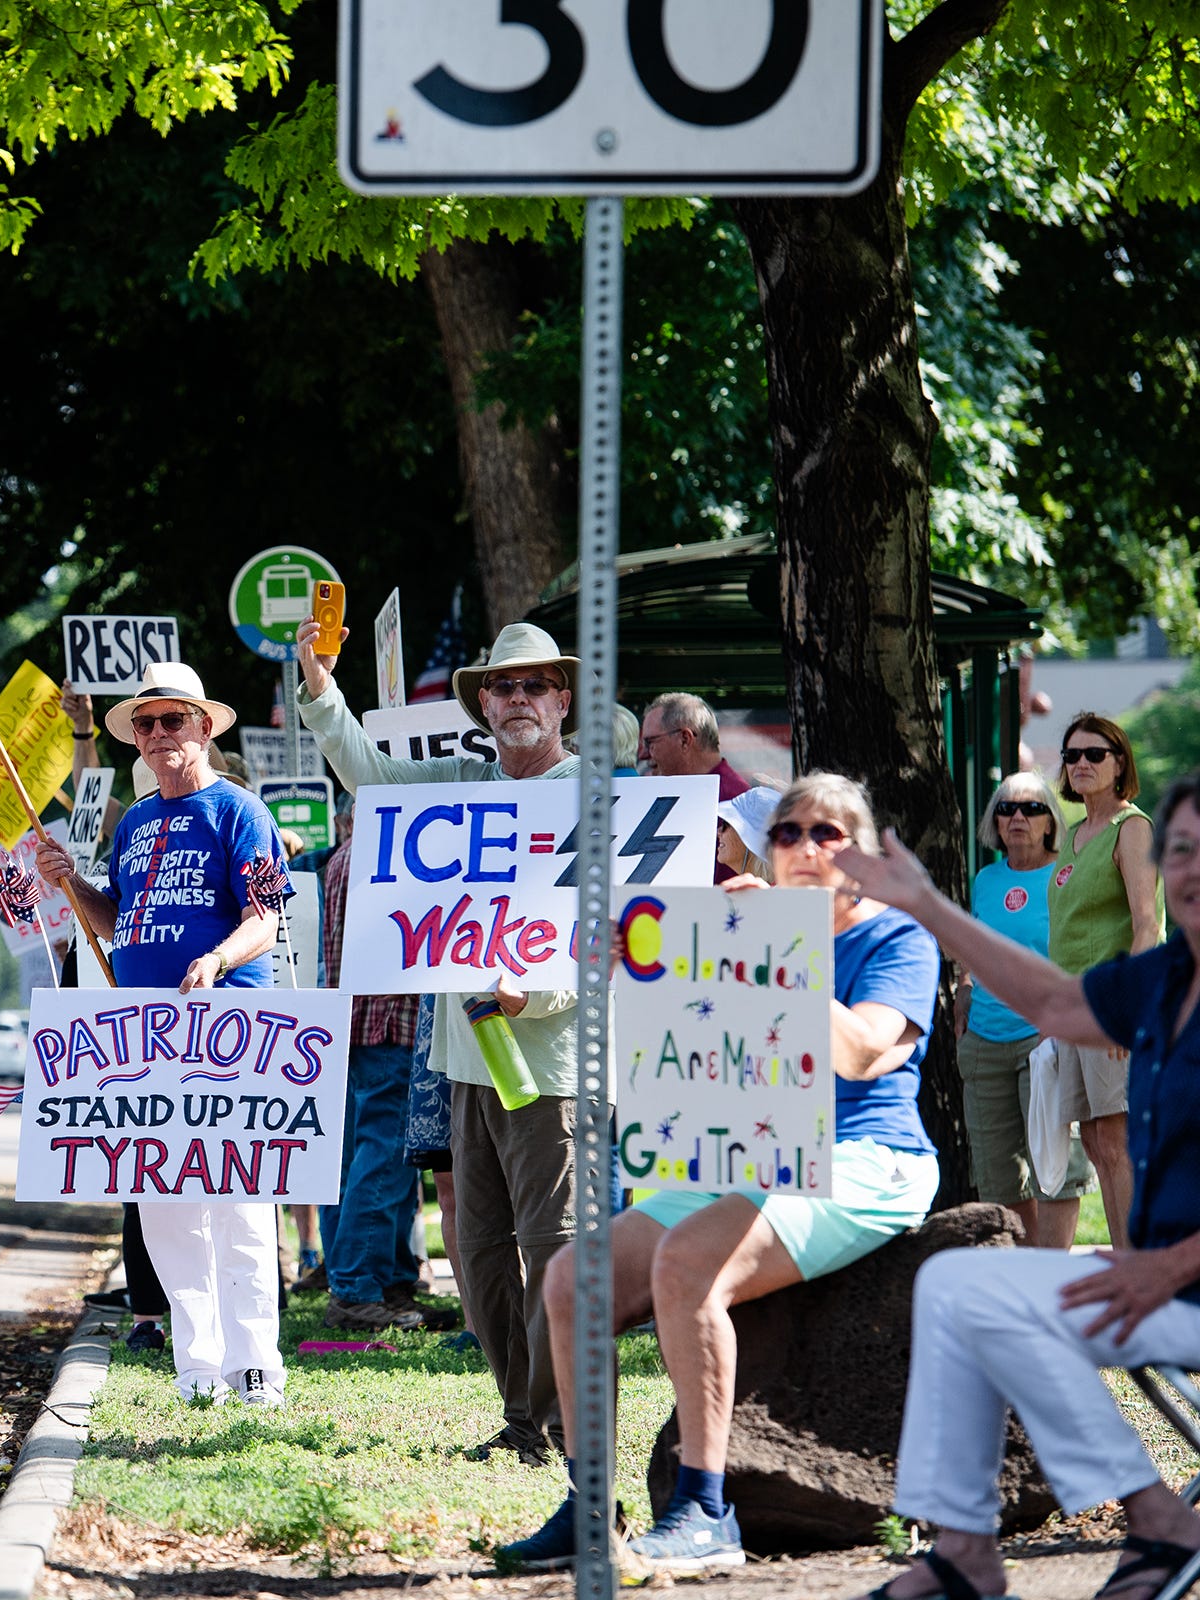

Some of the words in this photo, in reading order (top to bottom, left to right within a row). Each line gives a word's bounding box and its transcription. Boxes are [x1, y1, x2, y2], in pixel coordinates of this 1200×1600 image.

[69, 620, 174, 682] RESIST
[82, 776, 101, 804] NO
[131, 816, 193, 844] COURAGE
[370, 802, 518, 884] ICE
[119, 835, 168, 873] FREEDOM
[129, 850, 211, 876] DIVERSITY
[145, 868, 205, 889] RIGHTS
[132, 888, 216, 908] KINDNESS
[113, 924, 185, 950] EQUALITY
[388, 893, 558, 977] Wake
[32, 1002, 333, 1087] PATRIOTS
[35, 1094, 175, 1128] STAND
[182, 1094, 234, 1128] UP
[238, 1095, 290, 1130] TO
[285, 1096, 325, 1136] A
[50, 1135, 308, 1195] TYRANT
